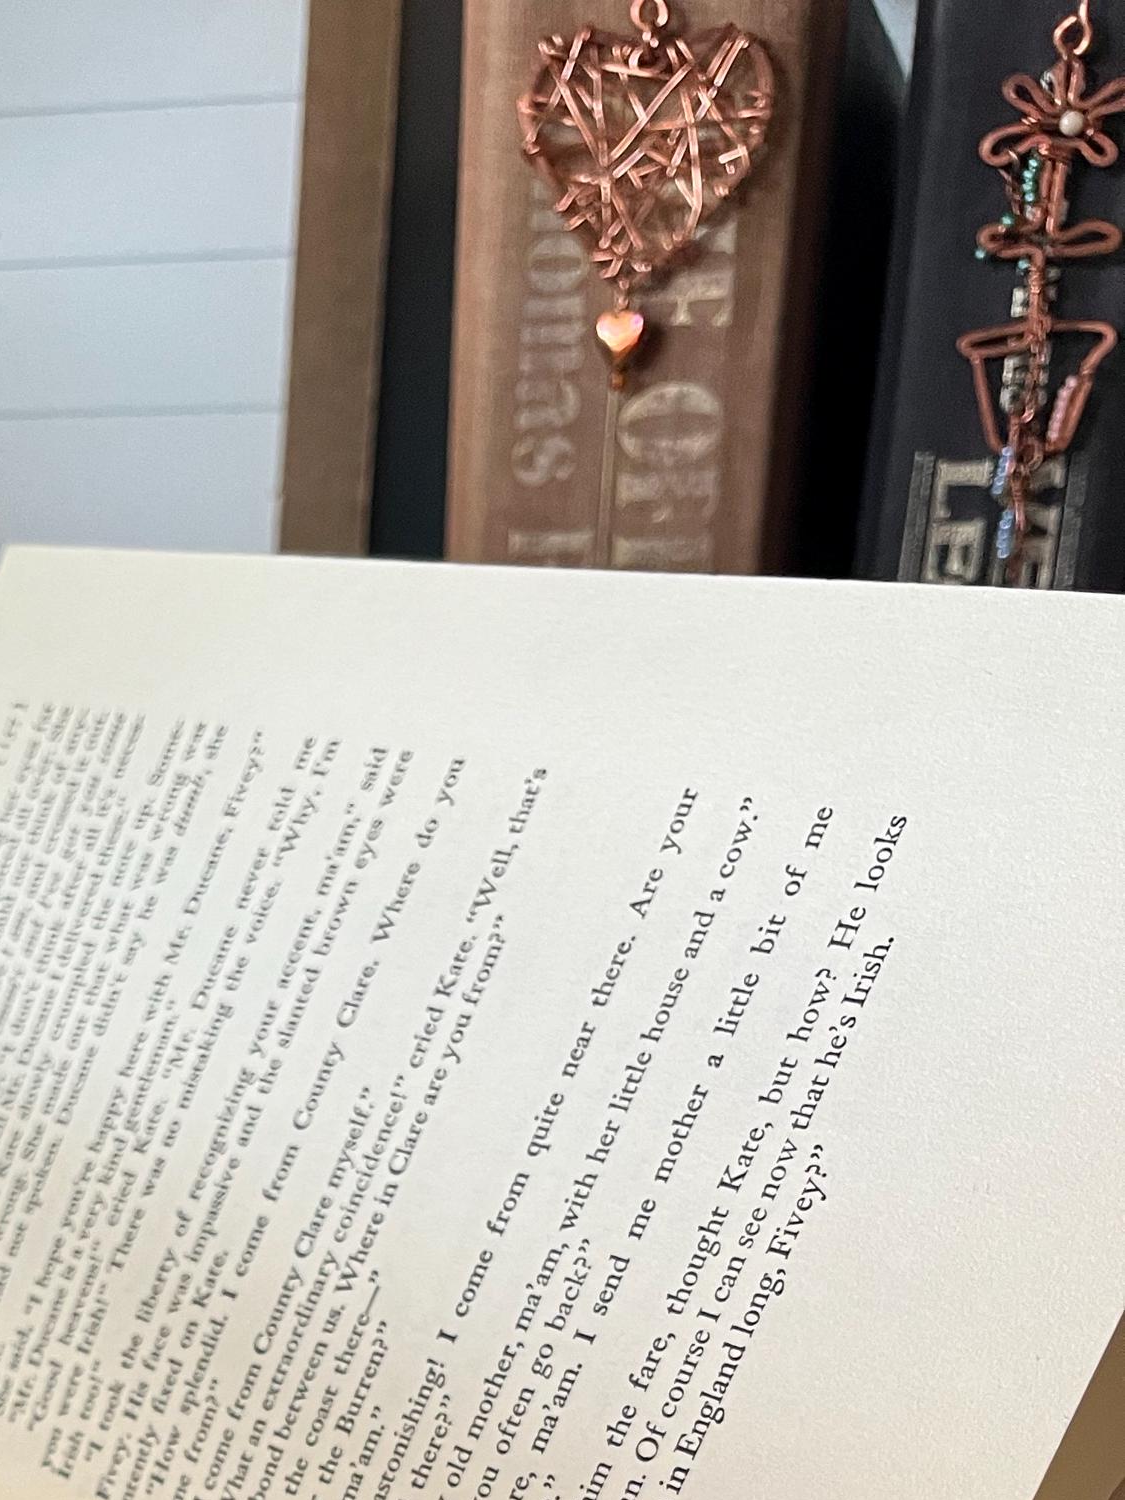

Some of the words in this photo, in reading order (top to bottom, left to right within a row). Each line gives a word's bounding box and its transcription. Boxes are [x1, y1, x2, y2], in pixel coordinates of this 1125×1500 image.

[804, 806, 833, 848] me
[784, 864, 807, 896] of
[749, 914, 786, 954] bit
[712, 972, 759, 1036] little
[436, 1328, 458, 1343] I
[455, 1249, 493, 1317] come
[486, 1172, 529, 1236] from
[527, 1093, 564, 1156] quite
[561, 1021, 595, 1078] near
[591, 935, 635, 1006] there.
[629, 868, 663, 919] Are
[659, 787, 698, 854] your
[707, 1054, 724, 1068] a
[446, 1444, 473, 1487] old
[467, 1341, 524, 1440] mother,
[515, 1243, 569, 1332] ma’am,
[558, 1173, 598, 1230] with
[585, 1119, 620, 1163] her
[607, 1051, 651, 1112] little
[639, 967, 689, 1042] house
[684, 910, 715, 958] and
[709, 888, 726, 902] a
[719, 796, 758, 878] cow.”
[605, 1404, 636, 1447] the
[628, 1332, 676, 1392] fare,
[666, 1205, 729, 1314] thought
[716, 1122, 774, 1193] Kate,
[757, 1056, 798, 1104] but
[785, 968, 836, 1042] how?
[826, 906, 866, 950] He
[853, 815, 907, 892] looks
[654, 1083, 708, 1183] mother
[627, 1198, 656, 1240] me
[635, 1420, 666, 1462] Of
[661, 1329, 710, 1418] course
[695, 1307, 721, 1322] I
[714, 1256, 746, 1302] can
[738, 1207, 767, 1249] see
[760, 1137, 797, 1200] now
[789, 1074, 829, 1129] that
[813, 1015, 856, 1068] he’s
[840, 937, 894, 1008] Irish.
[764, 1144, 827, 1259] Fivey?”
[592, 1254, 630, 1316] send
[729, 1268, 786, 1338] long,
[496, 1387, 535, 1454] often
[531, 1343, 553, 1379] go
[543, 1238, 591, 1331] back?”
[572, 1328, 596, 1344] I
[530, 1363, 582, 1454] ma’am.
[672, 1341, 746, 1460] England
[658, 1466, 690, 1495] in
